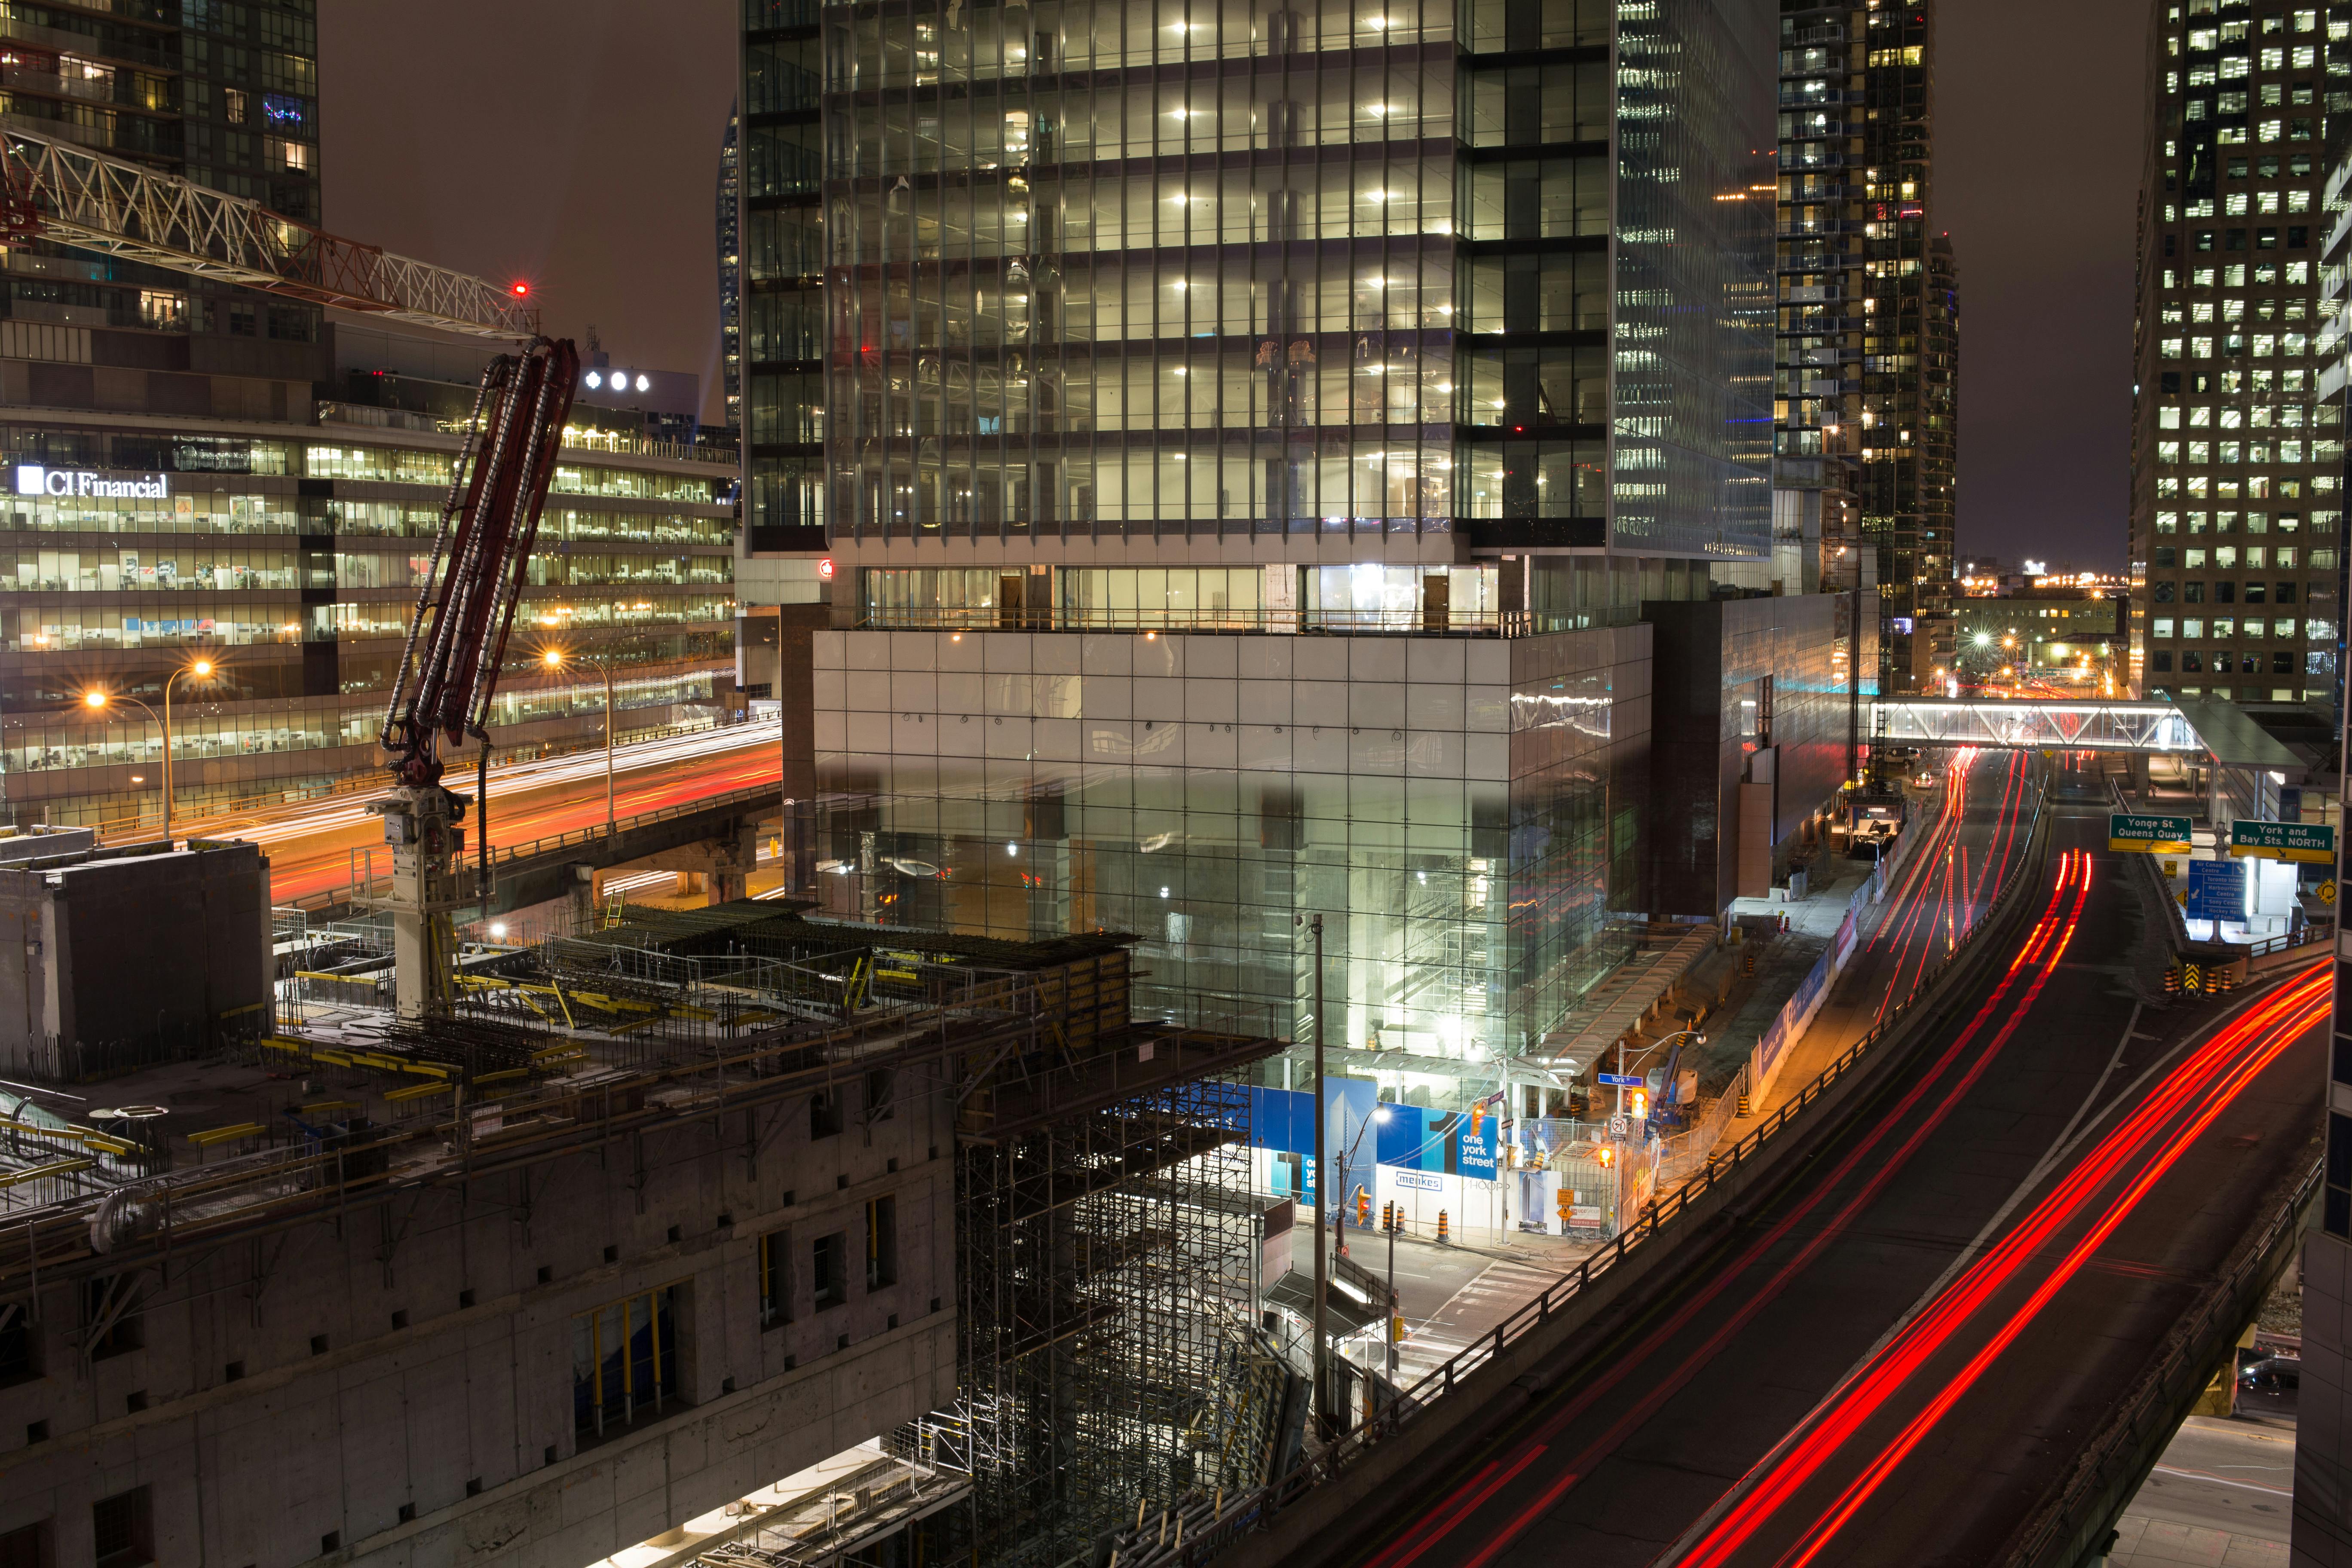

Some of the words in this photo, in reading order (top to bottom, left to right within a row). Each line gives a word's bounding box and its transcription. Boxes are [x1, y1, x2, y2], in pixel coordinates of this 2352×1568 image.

[46, 471, 74, 496] CI
[77, 472, 167, 499] Financial
[2128, 818, 2157, 829] Yonge
[2162, 820, 2175, 828] St.
[2119, 828, 2153, 837] Queens
[2158, 830, 2183, 840] Quay
[2259, 825, 2283, 835] York
[2240, 835, 2260, 845] Bay
[2264, 836, 2283, 845] Sts.
[2288, 838, 2325, 848] NORTH
[1463, 1135, 1483, 1145] one
[1463, 1145, 1486, 1156] york
[1463, 1155, 1494, 1168] street
[1400, 1176, 1439, 1187] menkes
